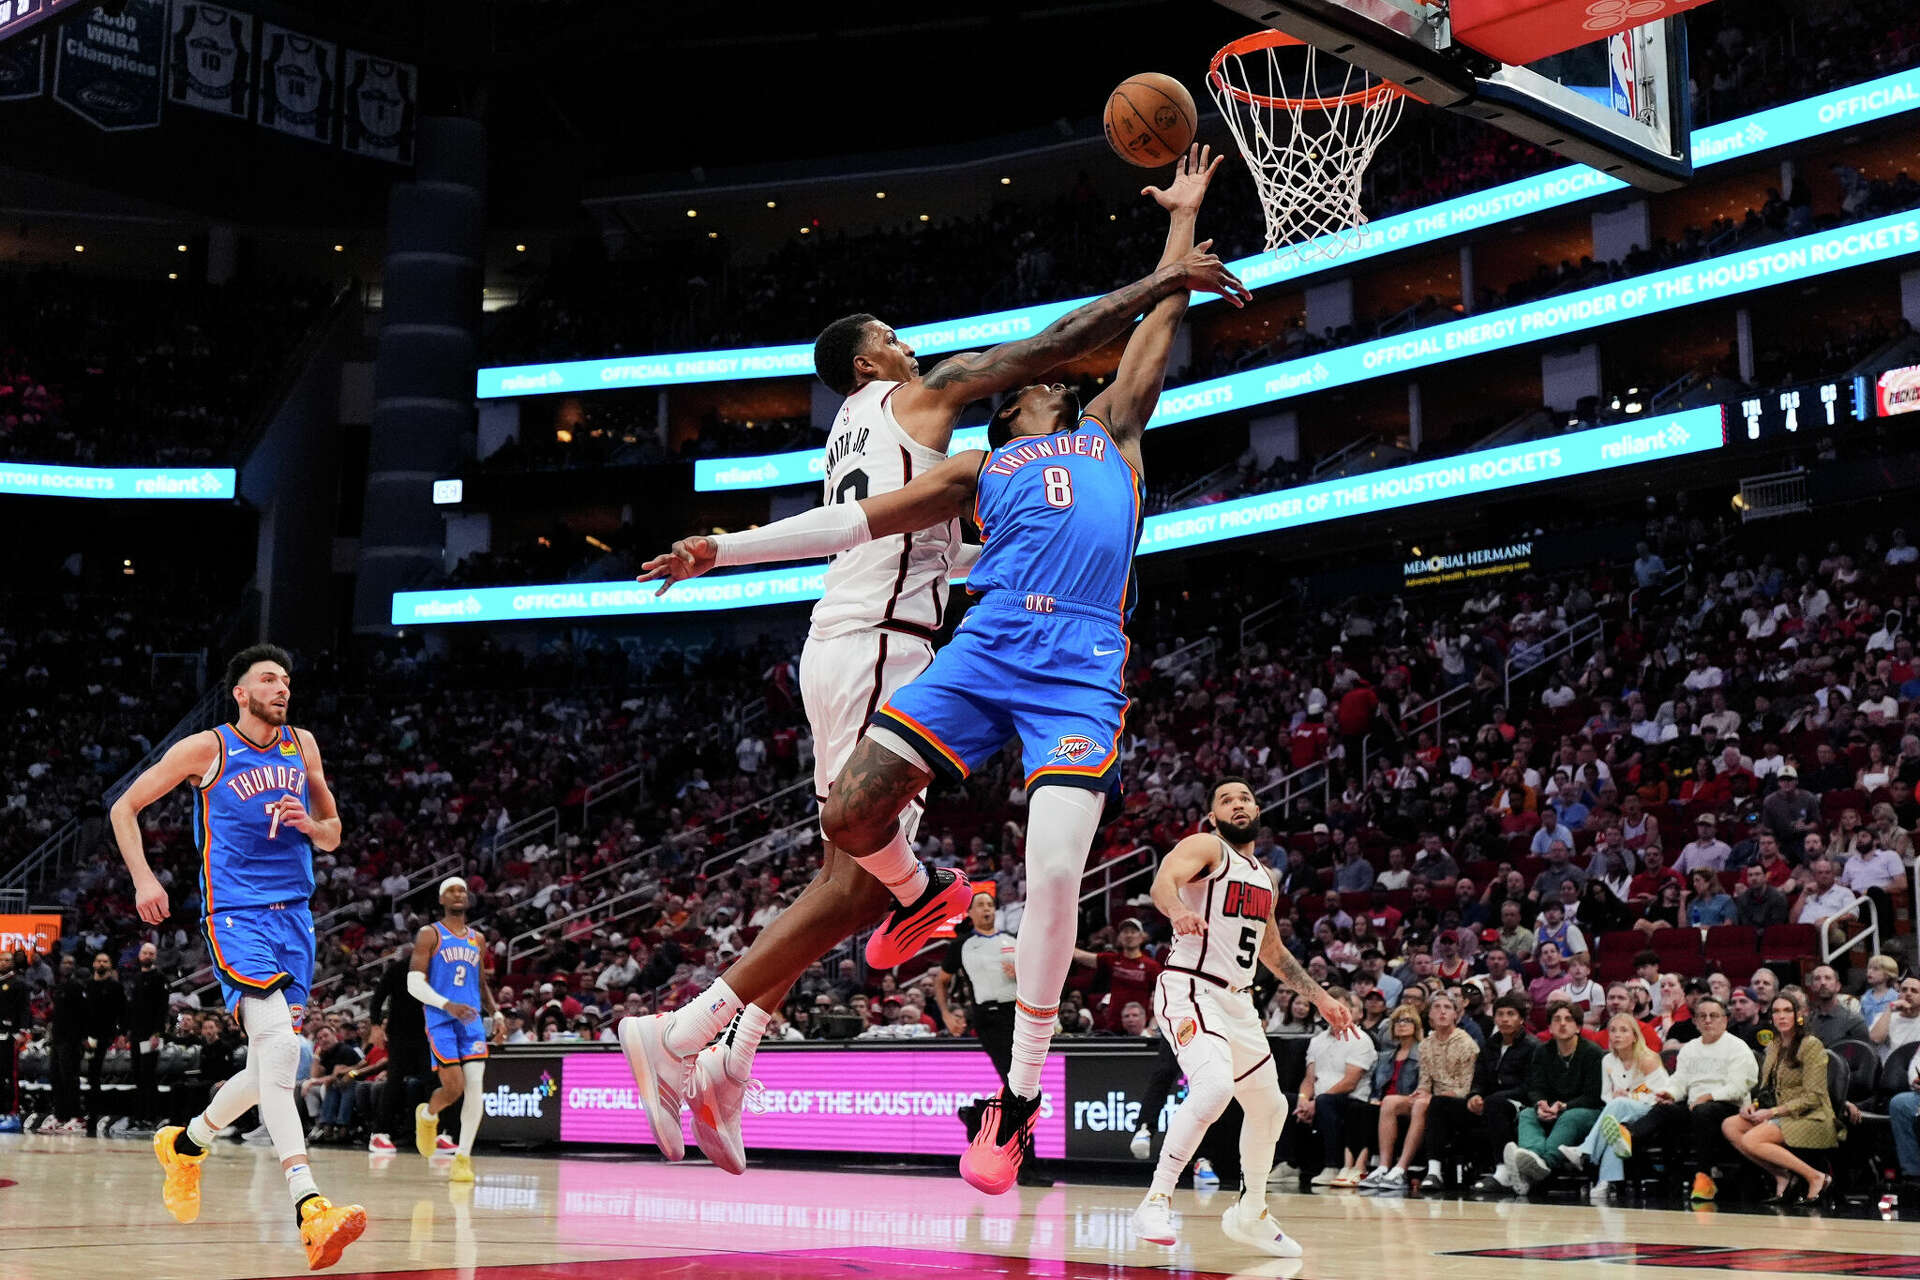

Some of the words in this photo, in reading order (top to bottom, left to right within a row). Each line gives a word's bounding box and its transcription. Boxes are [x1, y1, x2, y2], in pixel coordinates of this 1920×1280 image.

[87, 23, 140, 53] WNBA
[66, 38, 157, 77] Champions
[1818, 82, 1920, 123] OFFICIAL
[1240, 247, 1301, 283] ENERGY
[1383, 222, 1407, 244] OF
[1414, 212, 1447, 234] THE
[1451, 186, 1540, 224] HOUSTON
[1811, 221, 1919, 264] ROCKETS
[1363, 336, 1442, 369] OFFICIAL
[1445, 317, 1517, 350] ENERGY
[1520, 294, 1616, 332] PROVIDER
[1620, 286, 1648, 308] OF
[1652, 275, 1694, 300] THE
[1698, 248, 1806, 291] HOUSTON
[1811, 221, 1919, 264] ROCKETS
[600, 364, 671, 382] OFFICIAL
[675, 358, 737, 376] ENERGY
[957, 317, 1030, 341] ROCKETS
[1265, 370, 1311, 393] reliant
[852, 427, 870, 456] JR.
[986, 435, 1107, 477] THUNDER
[1601, 430, 1666, 460] reliant
[41, 474, 115, 490] ROCKETS
[136, 474, 199, 493] reliant
[715, 467, 761, 484] reliant
[1043, 466, 1075, 508] 8
[1154, 515, 1216, 542] ENERGY
[1220, 498, 1302, 529] PROVIDER
[1306, 493, 1329, 512] OF
[1329, 485, 1368, 507] THE
[1372, 466, 1465, 500] HOUSTON
[1469, 448, 1562, 482] ROCKETS
[1403, 554, 1466, 576] MEMORIAL
[1467, 543, 1531, 565] HERMANN
[513, 592, 588, 611] OFFICIAL
[590, 589, 660, 607] ENERGY
[660, 584, 741, 603] PROVIDER
[742, 581, 765, 597] OF
[765, 577, 802, 594] THE
[1025, 594, 1056, 613] OKC
[1056, 742, 1088, 757] OKC
[227, 766, 306, 802] THUNDER
[264, 802, 281, 840] 7
[440, 946, 480, 968] THUNDER
[1236, 926, 1257, 969] 5
[453, 965, 467, 987] 2
[568, 1088, 638, 1110] OFFICIAL
[788, 1091, 814, 1113] OF
[815, 1091, 853, 1114] THE
[854, 1091, 955, 1116] HOUSTON
